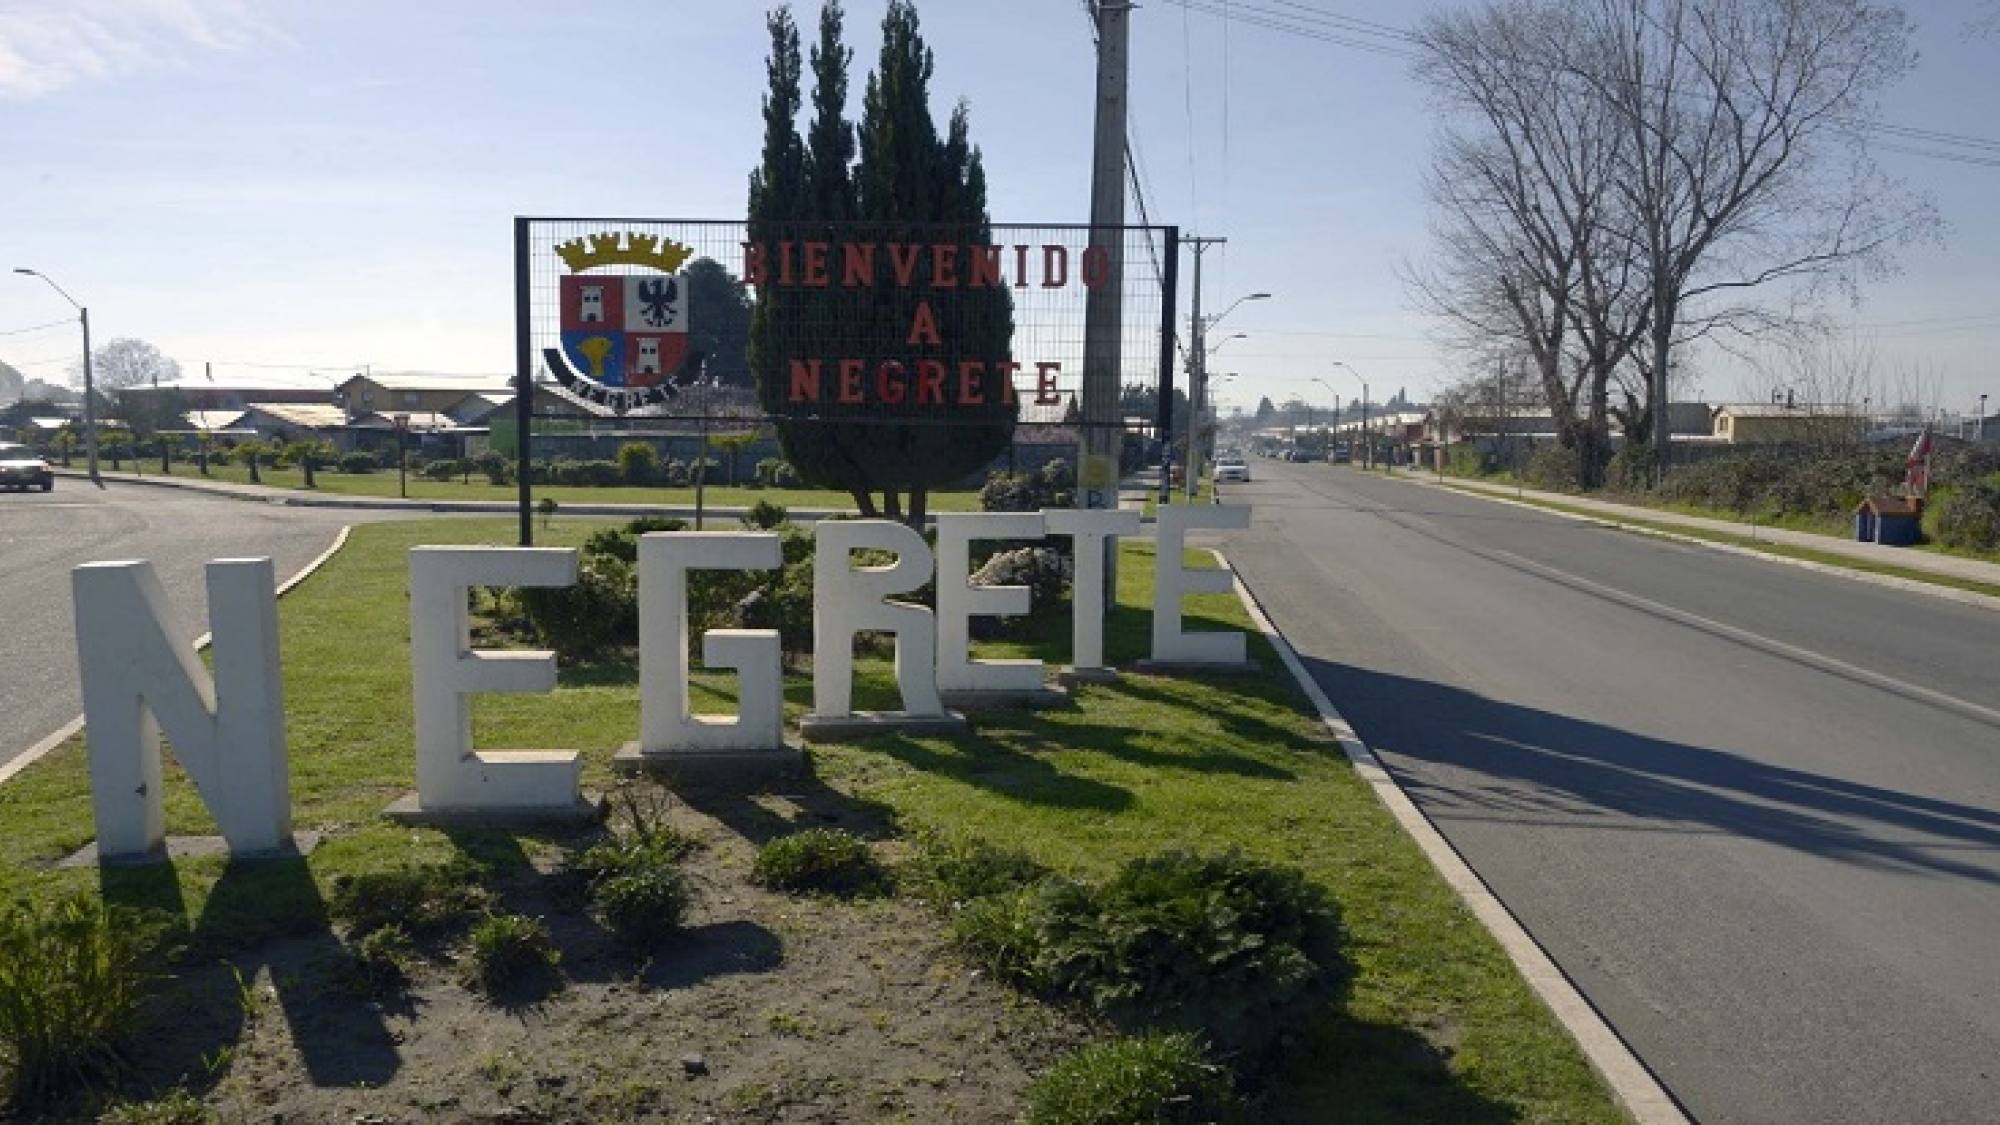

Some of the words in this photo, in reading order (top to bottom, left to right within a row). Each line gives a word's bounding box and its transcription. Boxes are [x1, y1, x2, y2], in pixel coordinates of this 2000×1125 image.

[740, 241, 1113, 288] BIENVENIDO
[908, 301, 941, 344] A
[788, 359, 1062, 405] NEGRETE
[73, 503, 1250, 858] NEGRETE
